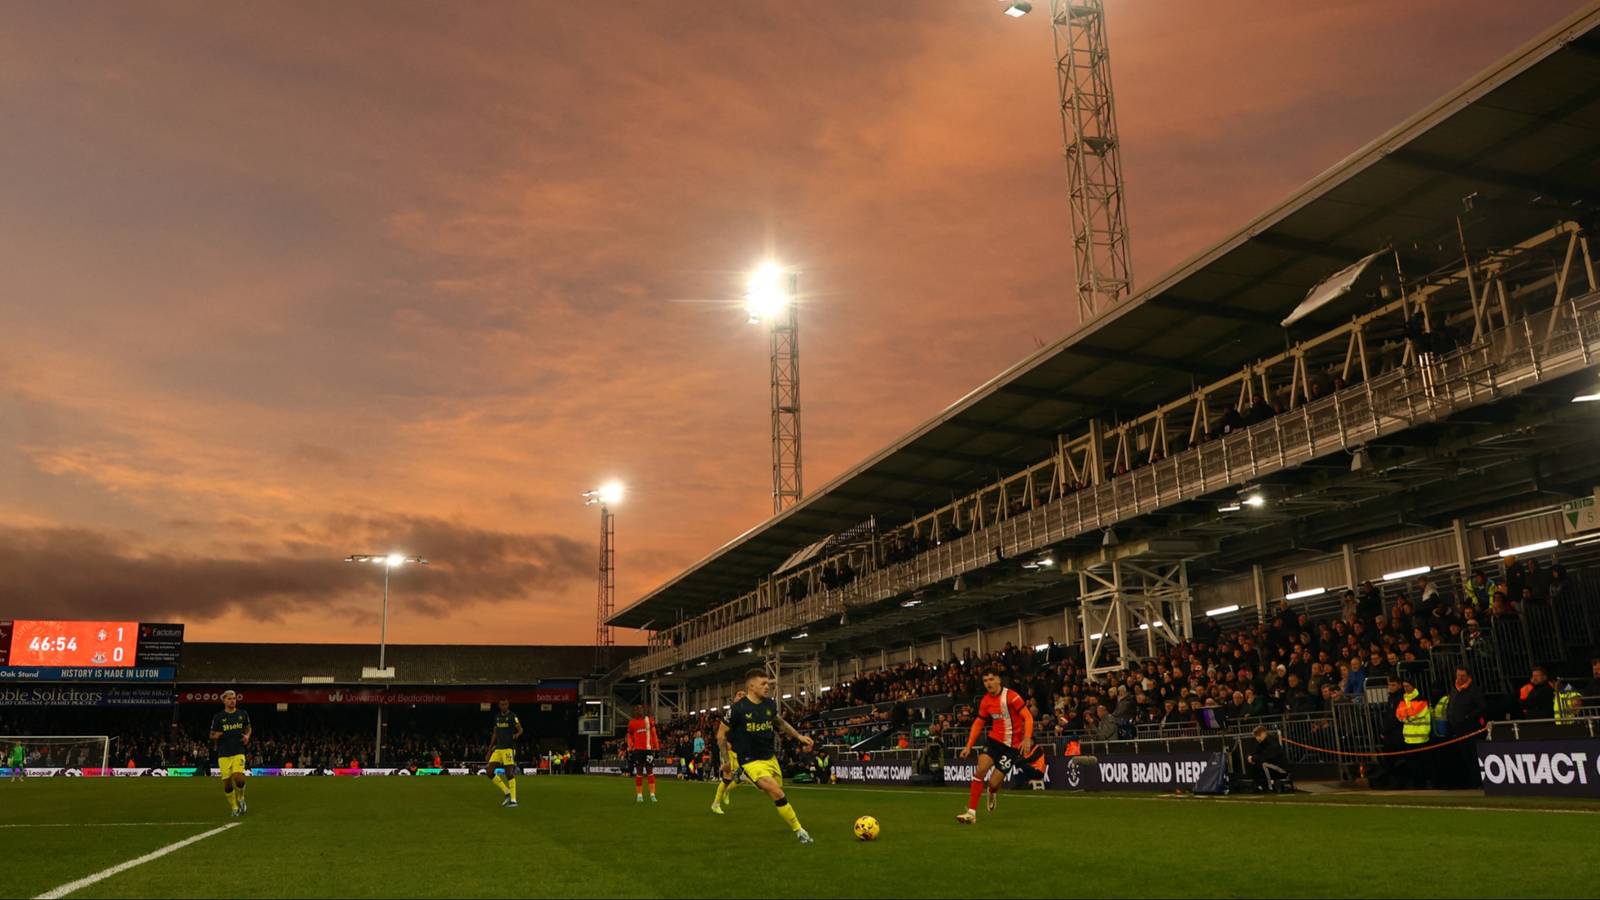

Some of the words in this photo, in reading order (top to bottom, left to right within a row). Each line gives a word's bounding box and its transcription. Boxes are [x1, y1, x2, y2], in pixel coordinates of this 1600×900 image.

[117, 627, 124, 642] 1
[29, 636, 77, 651] 46:54
[113, 647, 124, 662] 0
[0, 670, 16, 678] Oak
[18, 670, 39, 678] Stand
[61, 669, 93, 678] HISTORY
[94, 669, 103, 678] IS
[104, 669, 124, 678] MADE
[125, 669, 134, 678] IN
[135, 669, 159, 678] LUTON
[32, 687, 102, 701] Solicitors
[386, 693, 396, 702] of
[398, 693, 447, 702] Bedfordshire
[998, 755, 1012, 769] 26
[28, 769, 52, 777] League
[114, 769, 138, 777] League
[849, 766, 865, 781] HERE,
[866, 766, 889, 780] CONTACT
[1099, 763, 1129, 783] YOUR
[1132, 763, 1172, 783] BRAND
